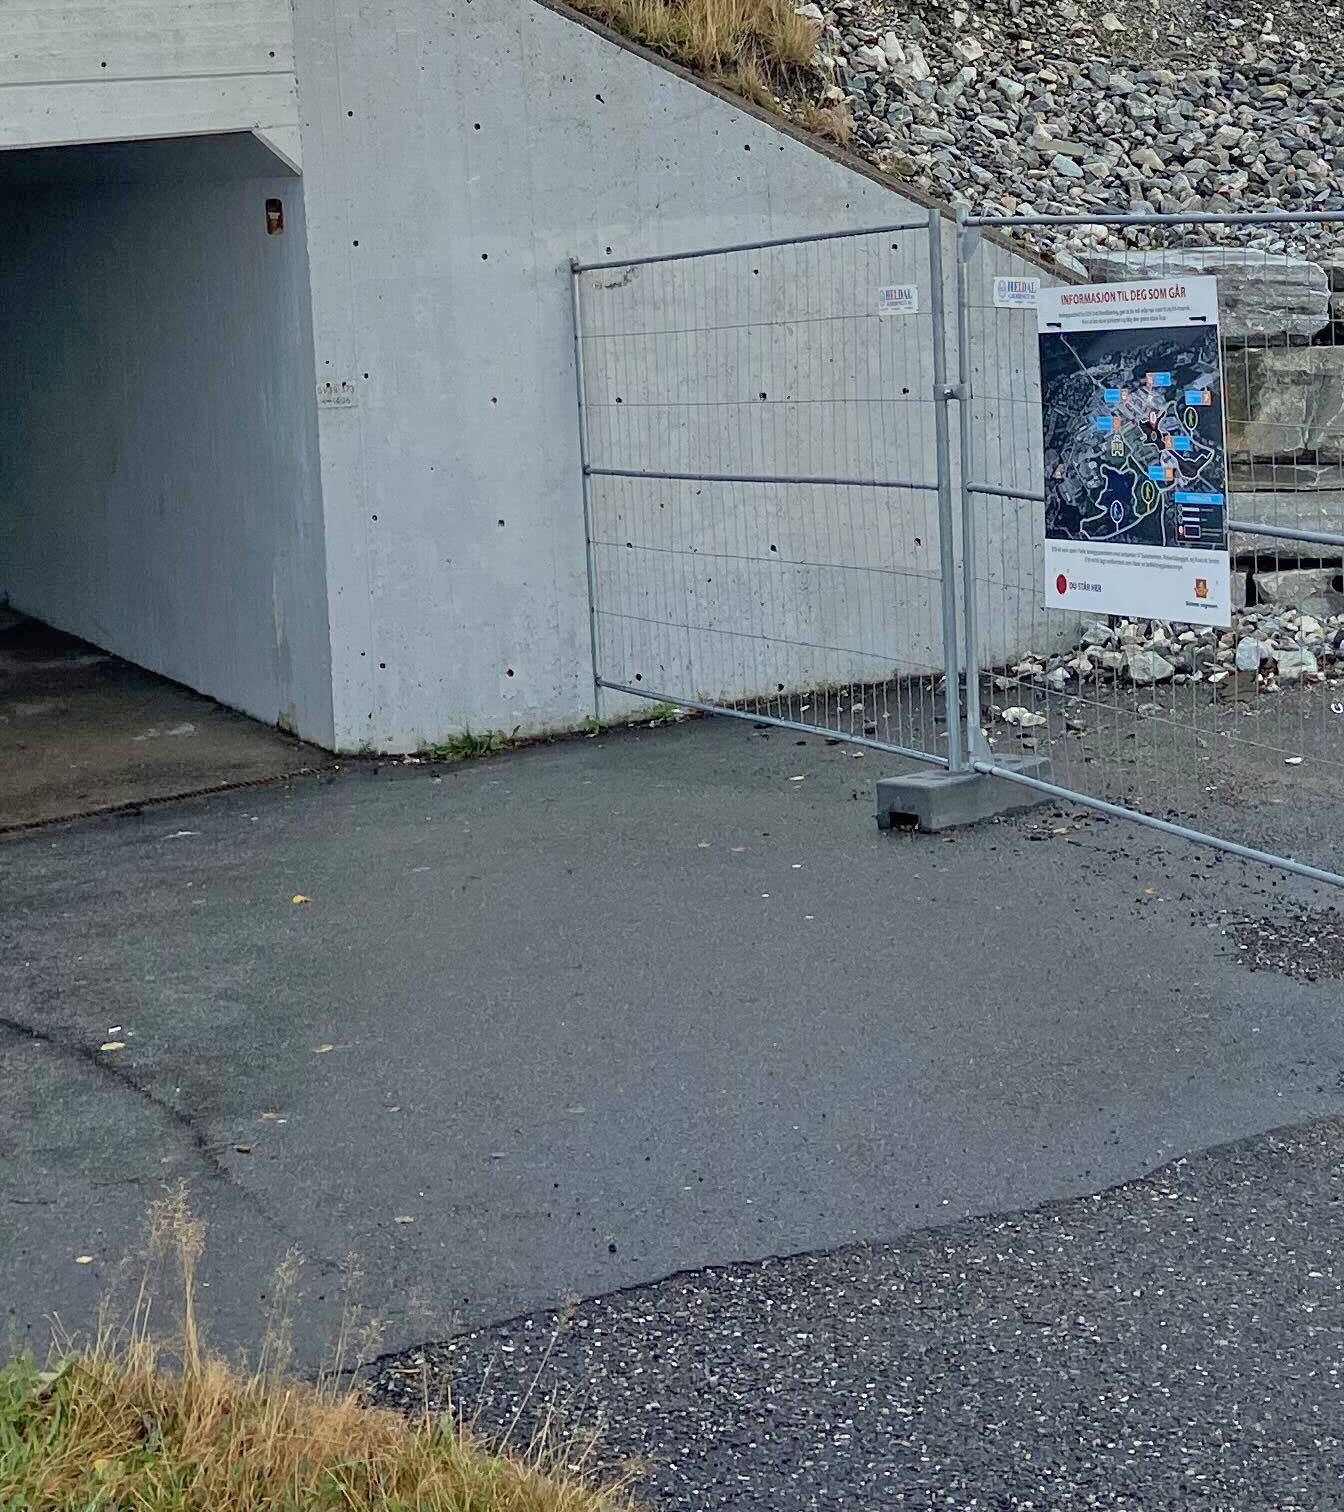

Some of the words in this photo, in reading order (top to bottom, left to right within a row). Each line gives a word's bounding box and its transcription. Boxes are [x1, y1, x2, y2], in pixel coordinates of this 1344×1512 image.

[1061, 291, 1116, 305] INFORMASJON
[1117, 290, 1129, 302] TIL
[1131, 289, 1147, 301] DEG
[1148, 287, 1167, 300] SOM
[1169, 284, 1186, 299] GÅR
